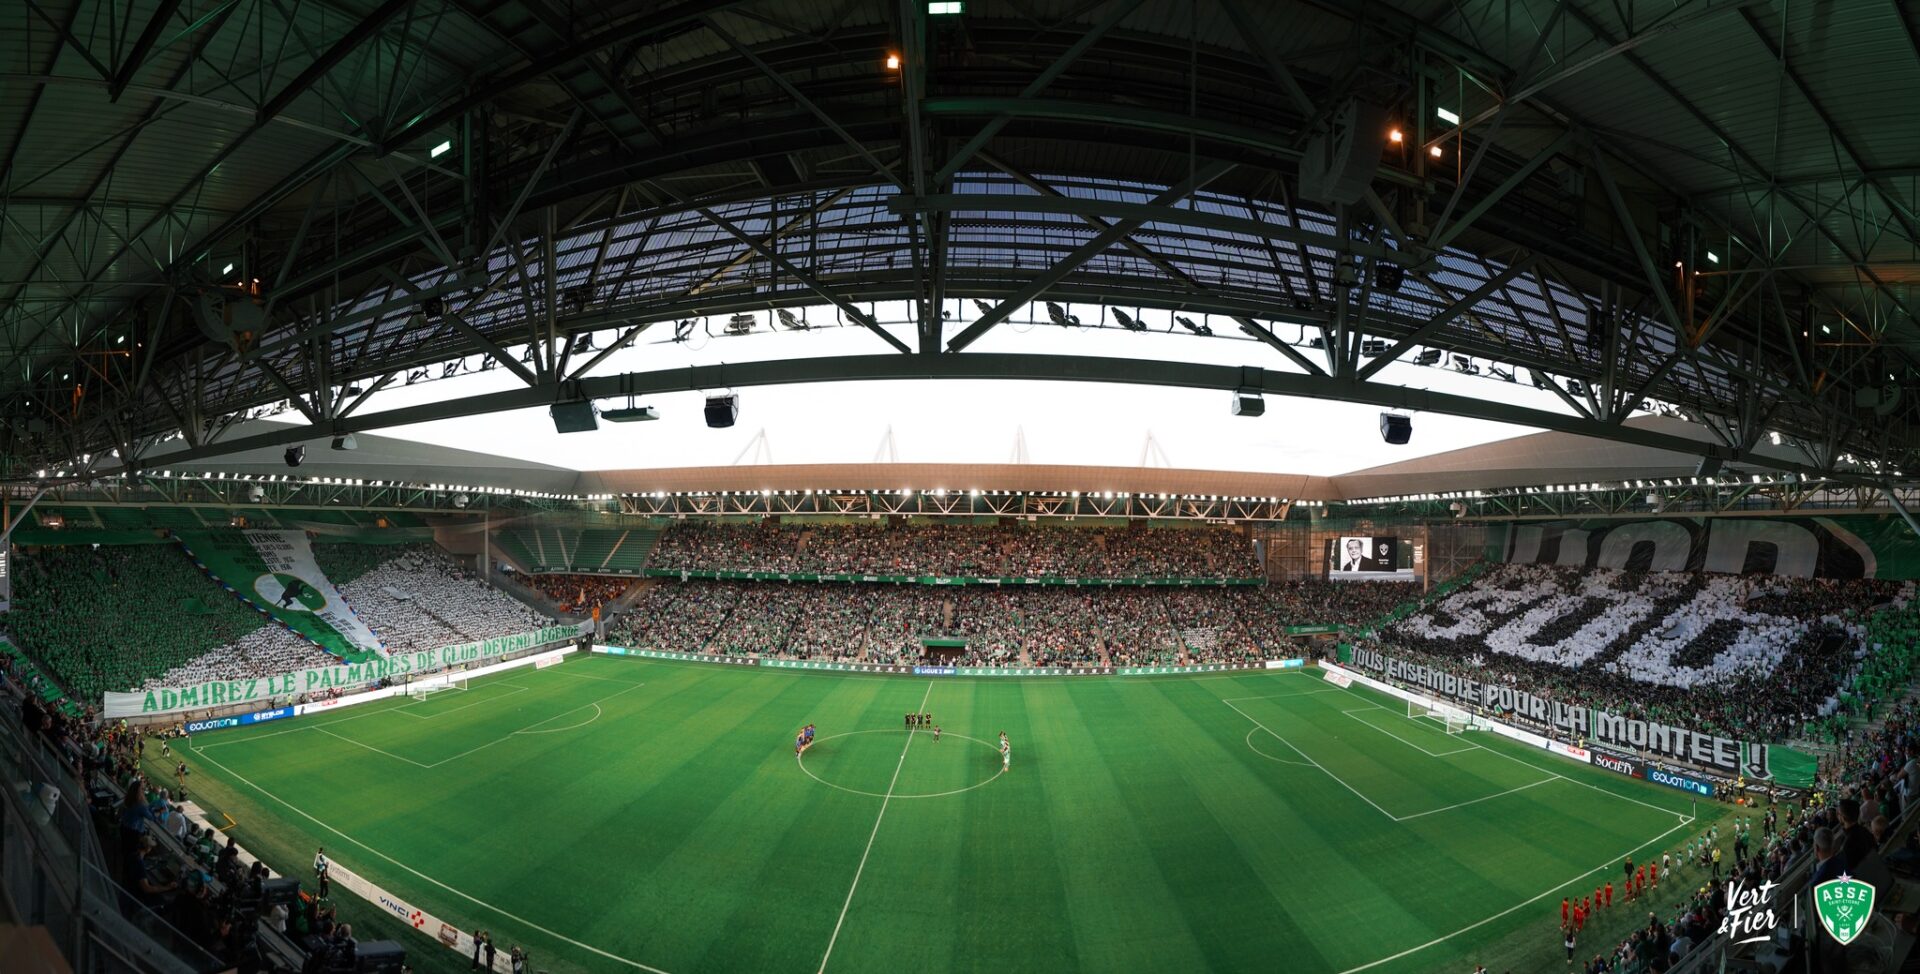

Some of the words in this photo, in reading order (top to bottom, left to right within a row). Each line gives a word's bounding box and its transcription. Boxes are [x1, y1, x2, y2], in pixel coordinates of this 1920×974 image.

[142, 680, 258, 713] ADMIREZ
[268, 673, 296, 696] LE
[417, 649, 437, 670] DE
[442, 644, 478, 664] CLUB
[484, 633, 530, 655] DEVENU
[1351, 646, 1384, 671] TOUS
[1388, 658, 1480, 702] ENSEMBLE
[1487, 685, 1545, 720] POUR
[1556, 702, 1586, 731] LA
[1597, 709, 1736, 768] MONTEE
[379, 896, 409, 918] VINCI
